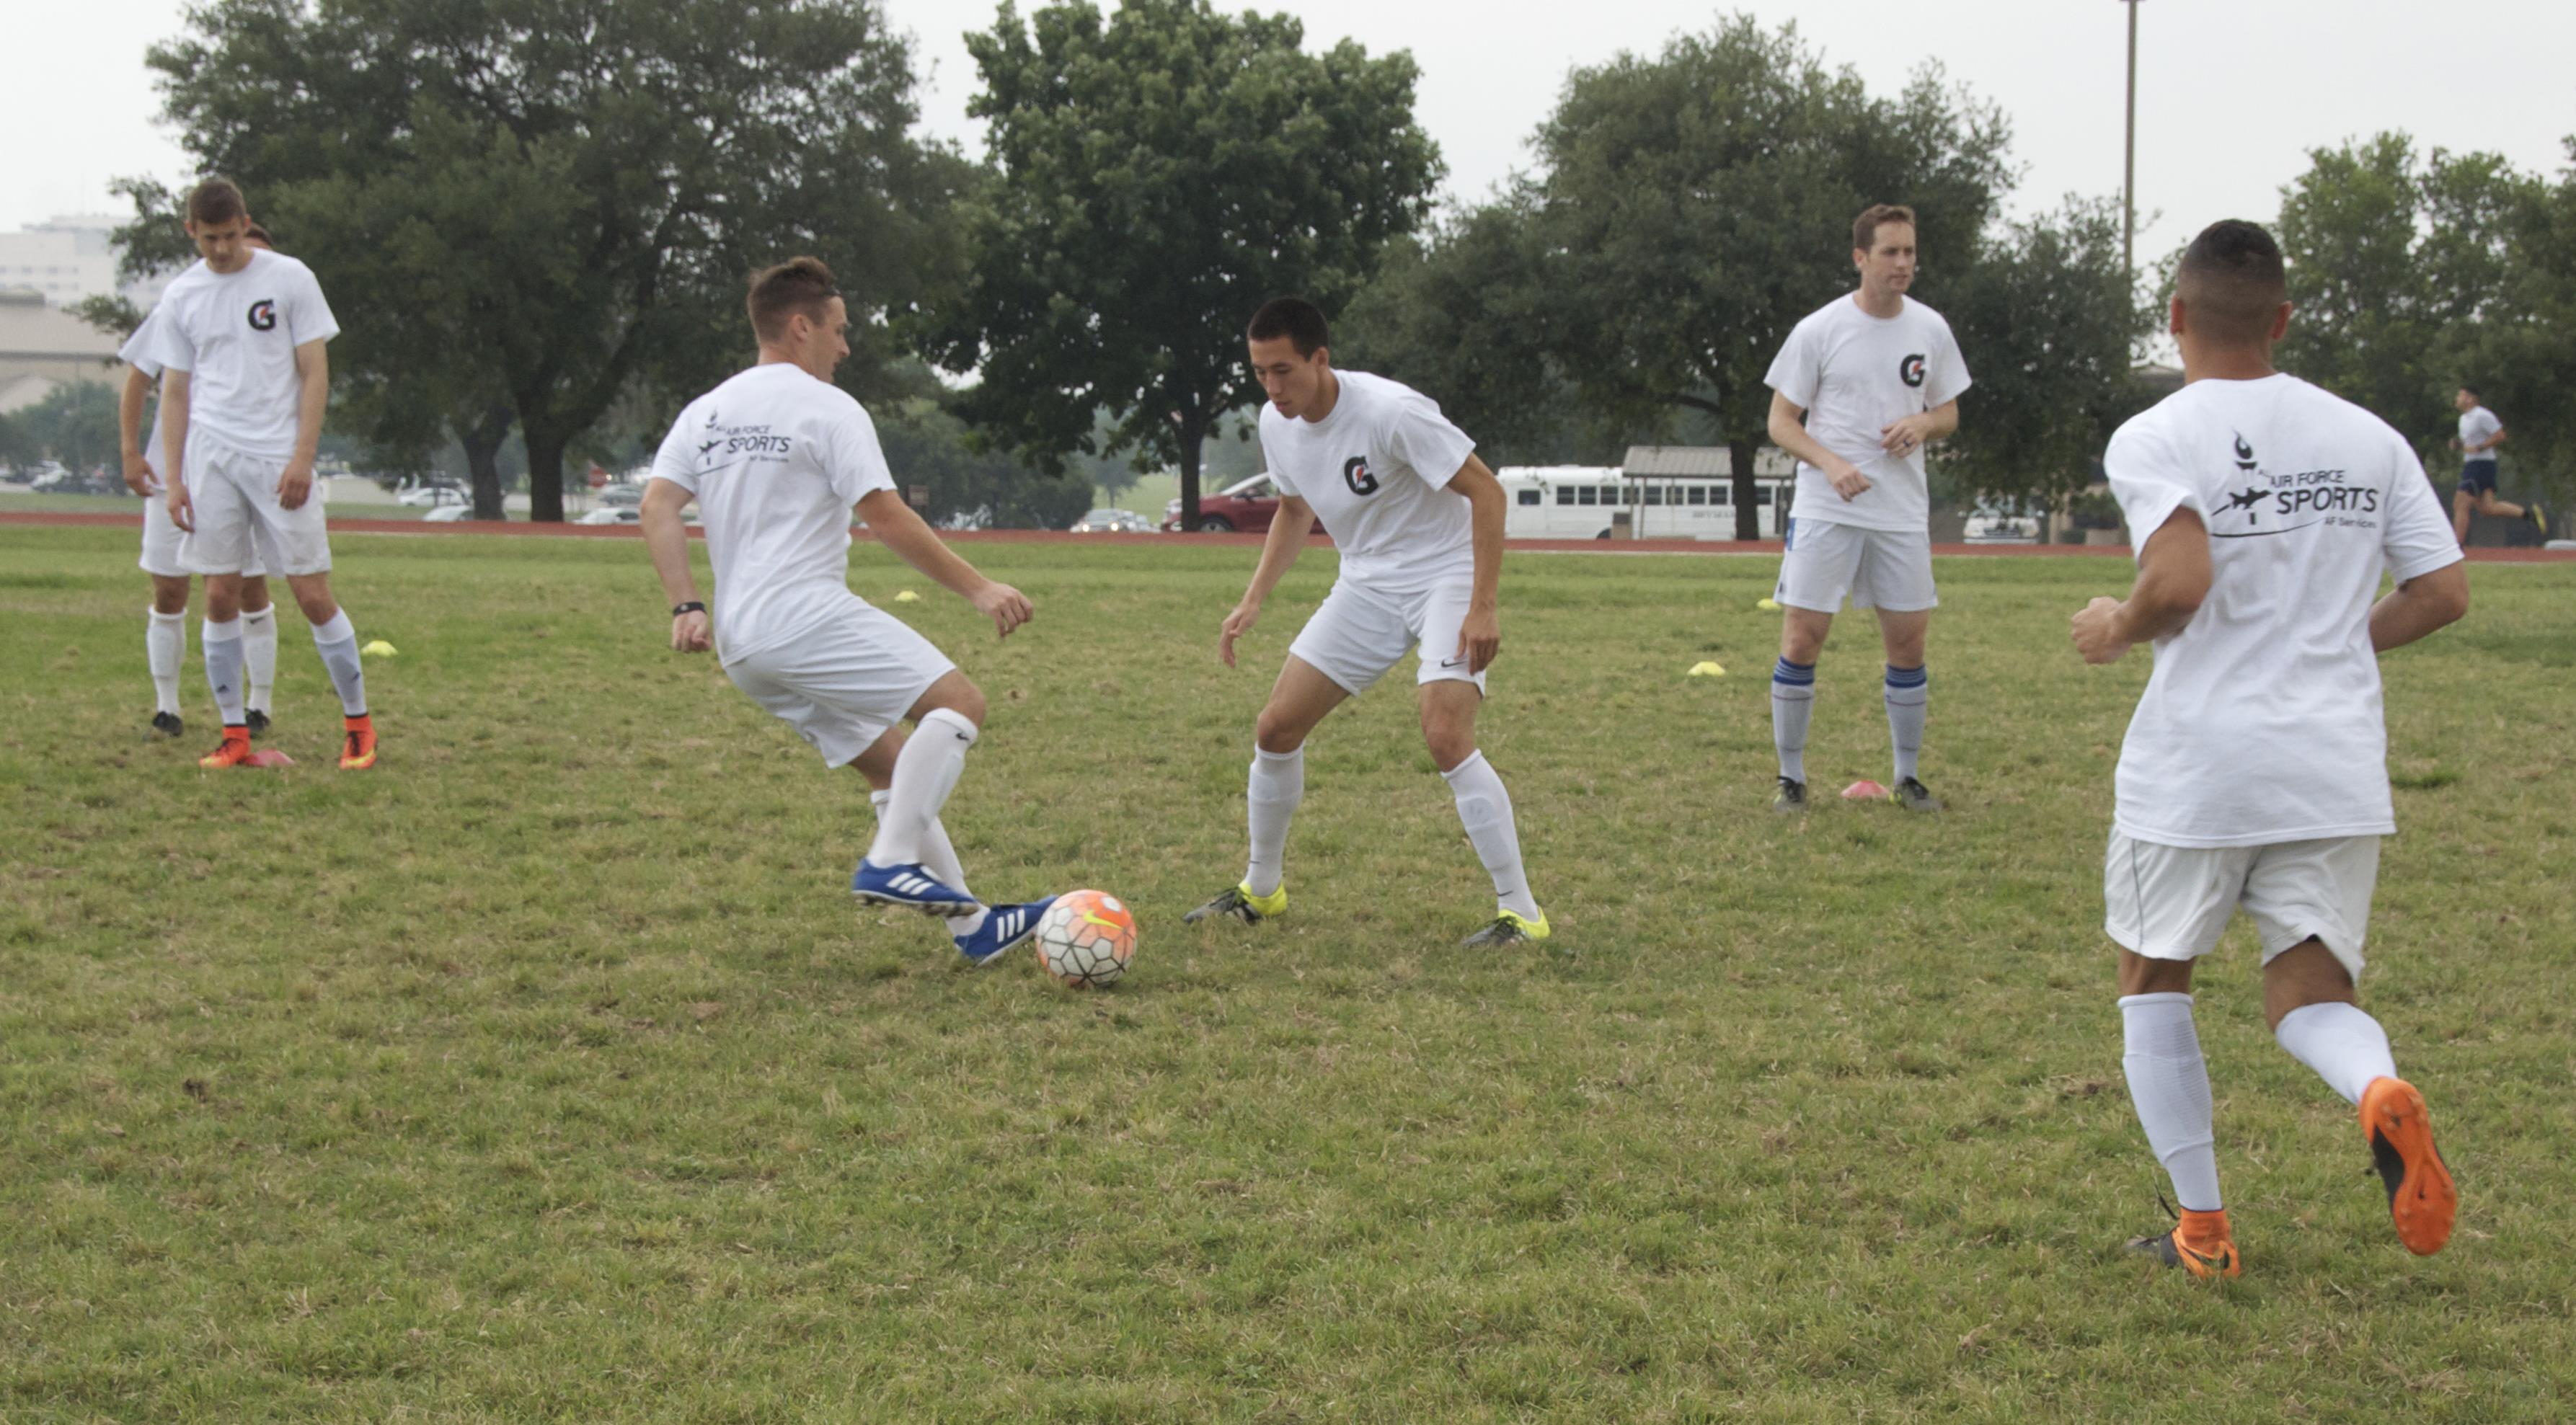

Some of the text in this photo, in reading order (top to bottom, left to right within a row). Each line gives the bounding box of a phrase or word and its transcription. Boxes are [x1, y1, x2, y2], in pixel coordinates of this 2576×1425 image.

[248, 298, 275, 332] G
[1900, 354, 1925, 388] G
[727, 435, 792, 453] SPORTS
[1345, 456, 1378, 496] G
[2296, 470, 2345, 486] FORCE
[2276, 487, 2378, 515] SPORTS
